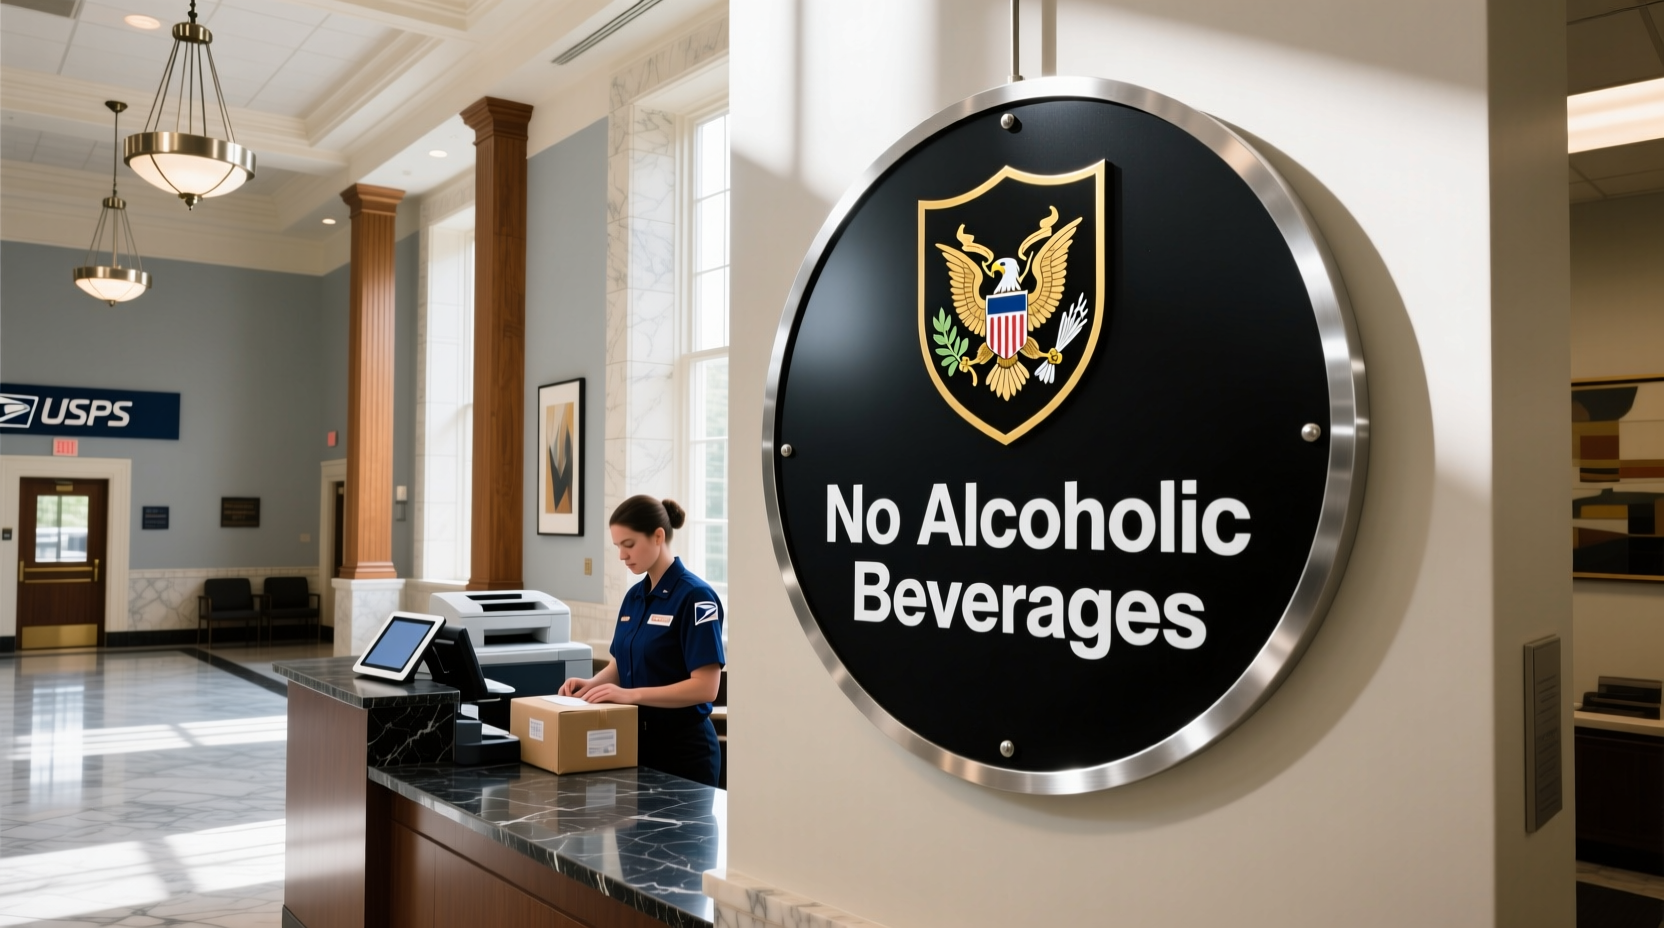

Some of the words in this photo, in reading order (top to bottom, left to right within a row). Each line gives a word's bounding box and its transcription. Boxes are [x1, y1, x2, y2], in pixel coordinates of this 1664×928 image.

[41, 397, 133, 427] USPS
[826, 483, 901, 545] No
[917, 479, 1252, 556] Alcoholic
[854, 560, 1207, 660] Beverages
